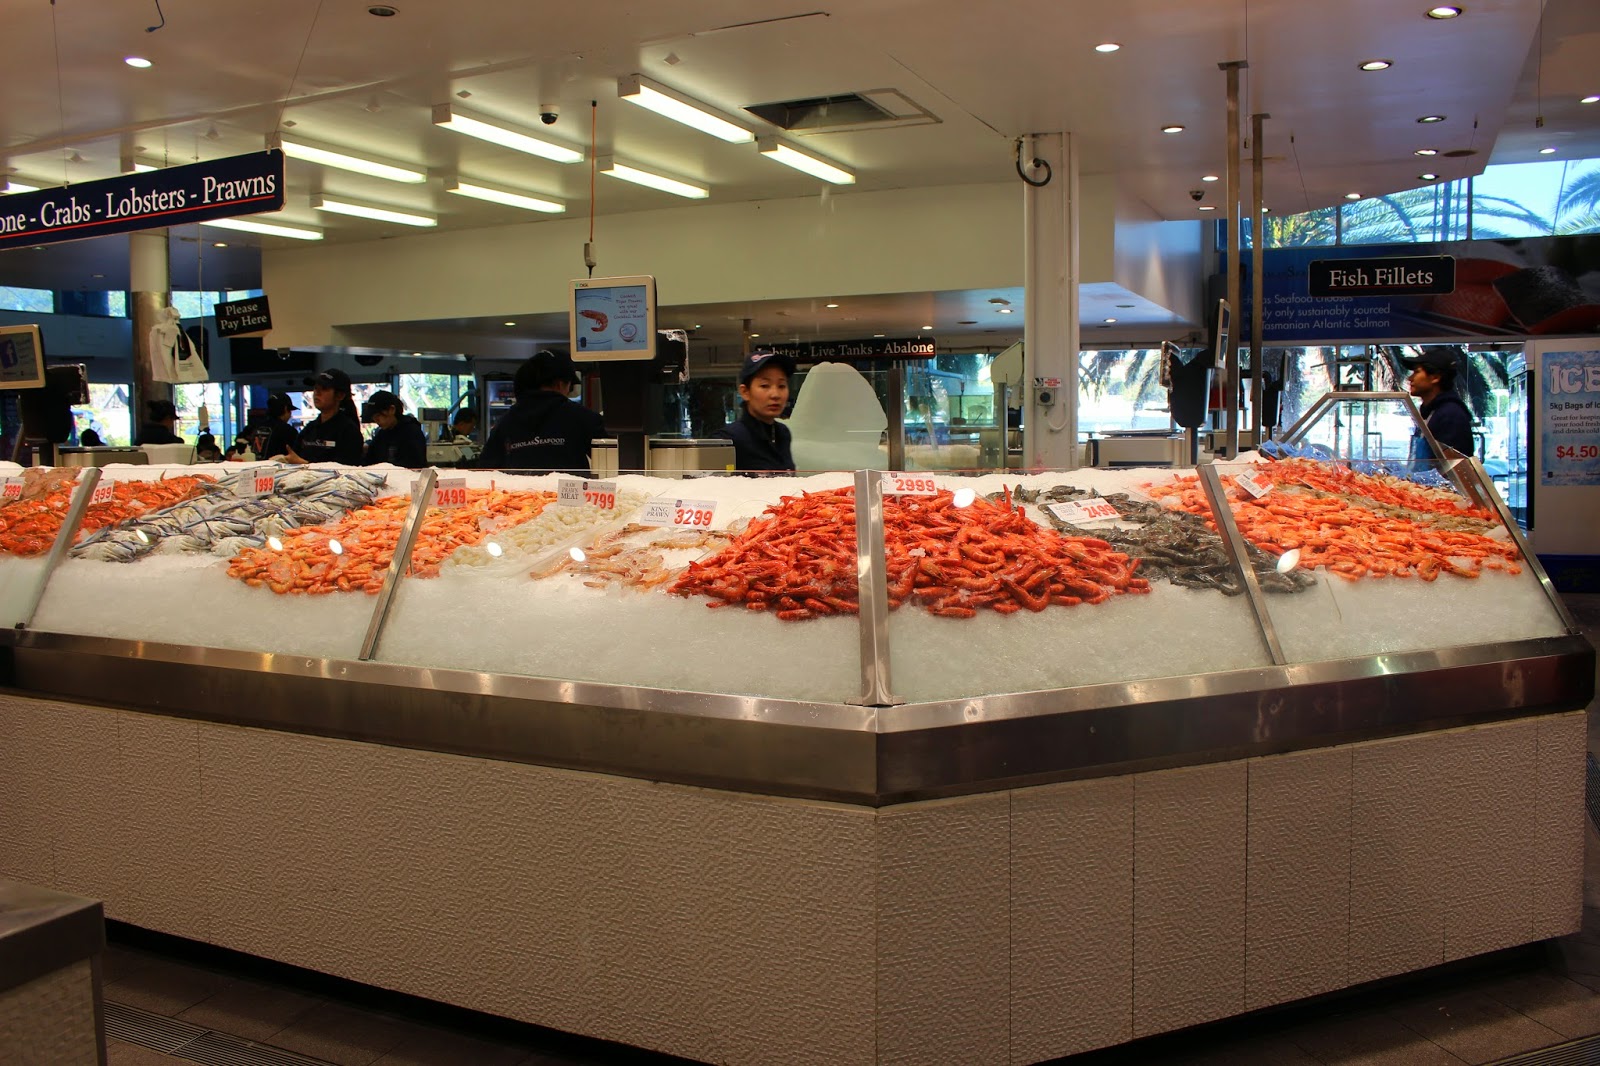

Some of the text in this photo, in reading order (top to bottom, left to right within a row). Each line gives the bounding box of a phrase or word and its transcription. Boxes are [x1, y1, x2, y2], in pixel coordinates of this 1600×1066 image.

[41, 196, 91, 228] Crabs
[106, 187, 186, 219] Lobsters
[202, 174, 276, 204] Prawns
[1329, 268, 1369, 287] Fish
[1374, 266, 1433, 286] Fillets
[1274, 293, 1313, 304] Seafood
[225, 302, 258, 316] Please
[1275, 306, 1295, 319] only
[1298, 305, 1350, 318] sustainably
[1353, 302, 1391, 315] sourced
[220, 315, 267, 331] Pay Here
[1312, 318, 1351, 329] Atlantic
[1354, 317, 1390, 328] Salmon
[811, 345, 836, 357] Live
[838, 343, 873, 356] Tanks
[883, 341, 934, 354] Abalone
[1549, 364, 1600, 394] ICE
[1550, 402, 1563, 411] 5kg
[1565, 402, 1583, 411] Bags
[1585, 401, 1593, 409] of
[1569, 420, 1583, 428] food
[1556, 445, 1598, 459] $4.50
